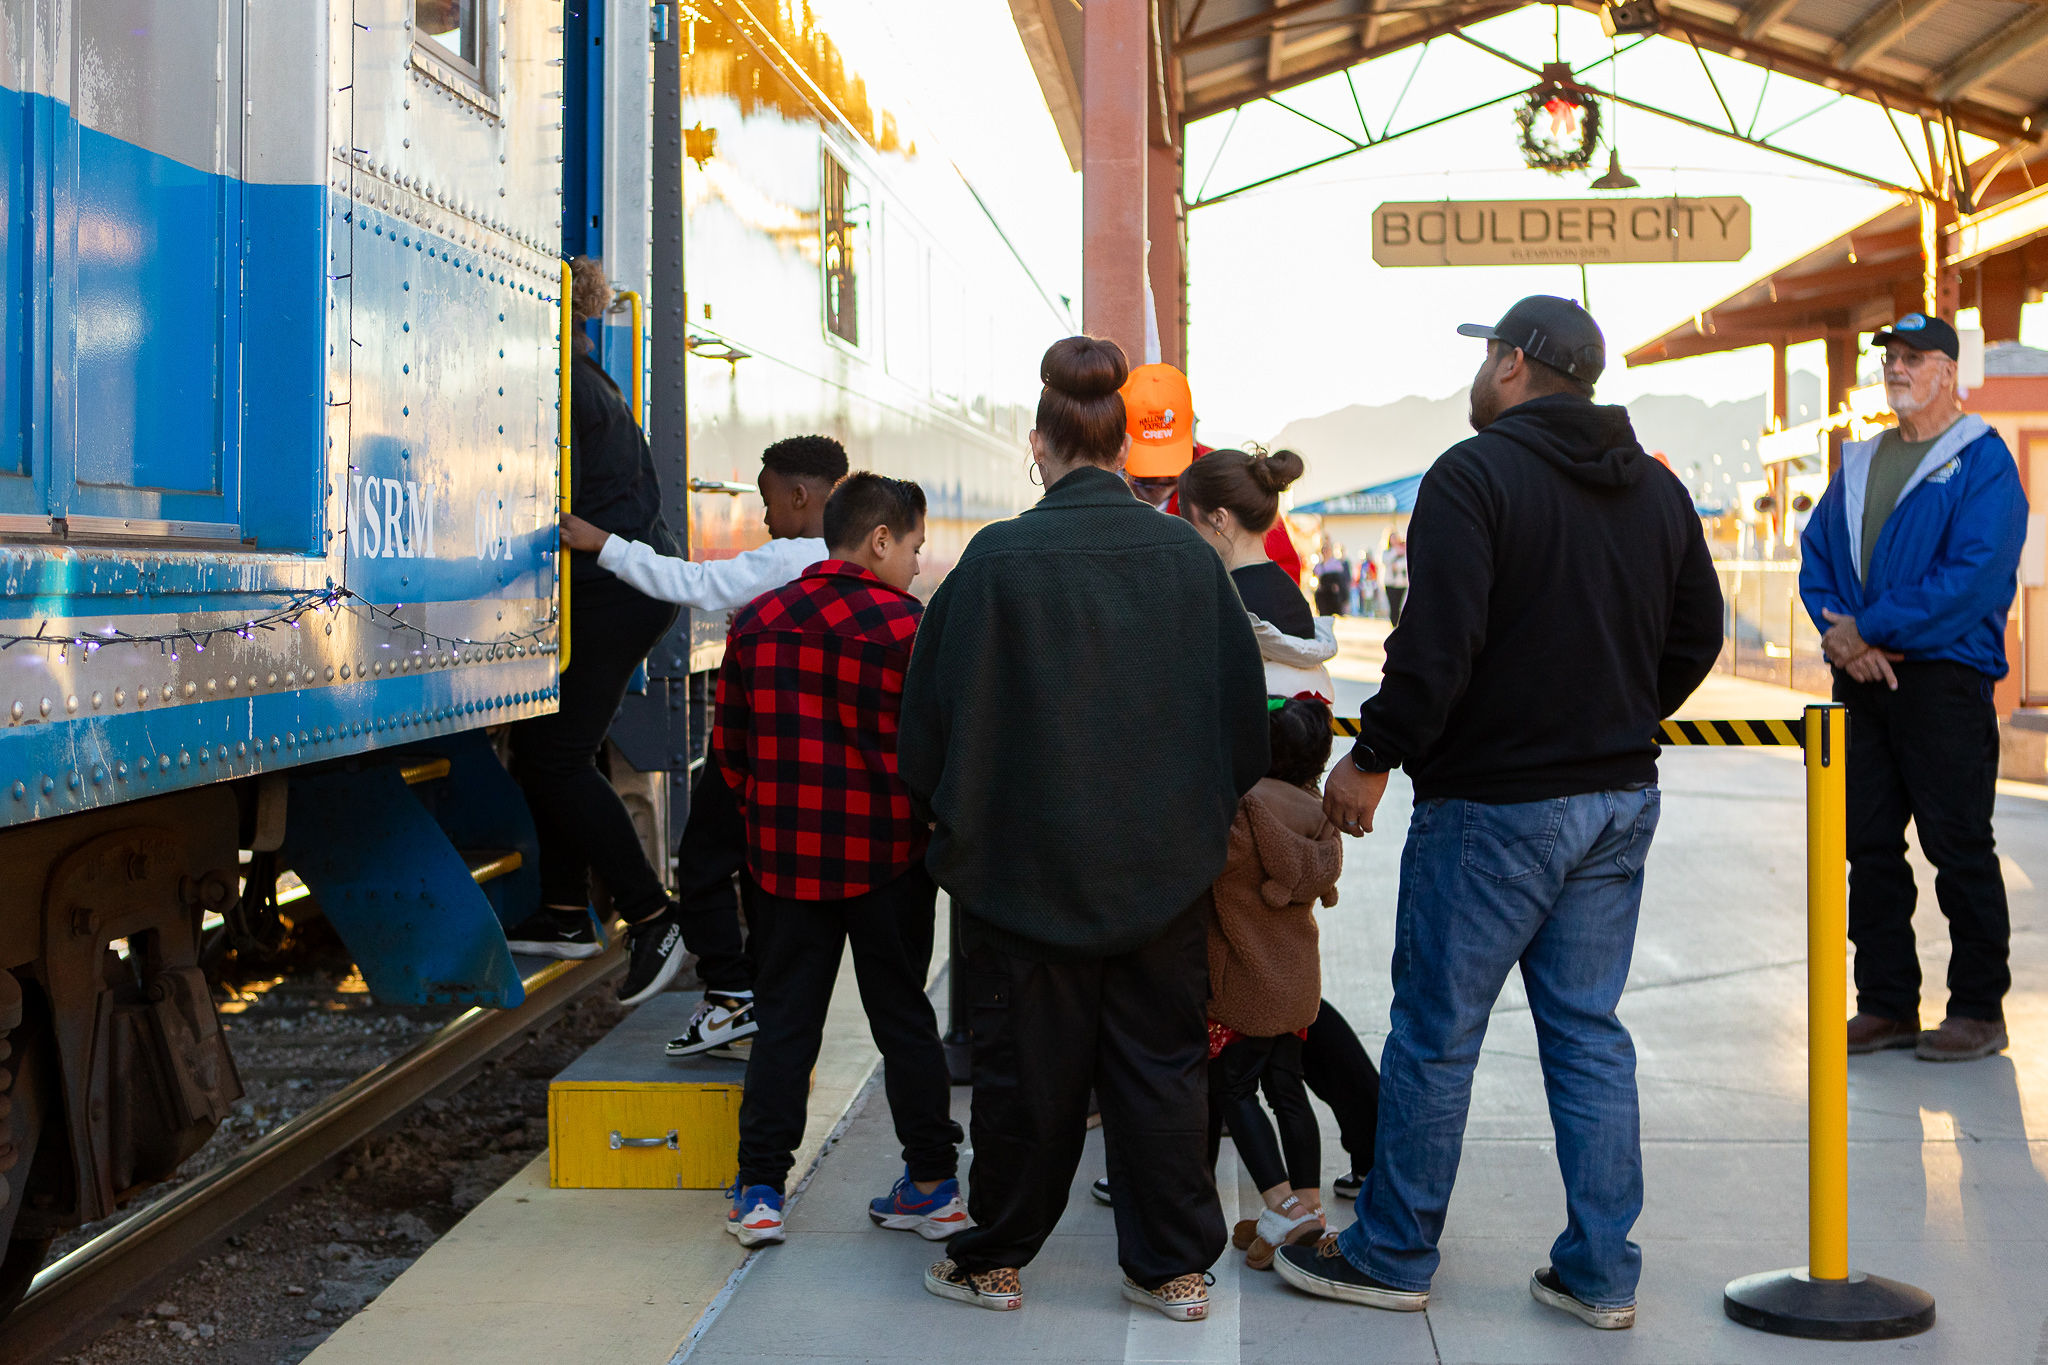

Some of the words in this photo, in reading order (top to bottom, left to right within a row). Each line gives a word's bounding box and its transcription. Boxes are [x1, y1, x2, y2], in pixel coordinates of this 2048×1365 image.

[1383, 207, 1616, 245] BOULDER
[1631, 204, 1740, 242] CITY
[1142, 429, 1173, 439] CREW
[334, 473, 436, 560] NSRM
[657, 923, 680, 957] HOKA
